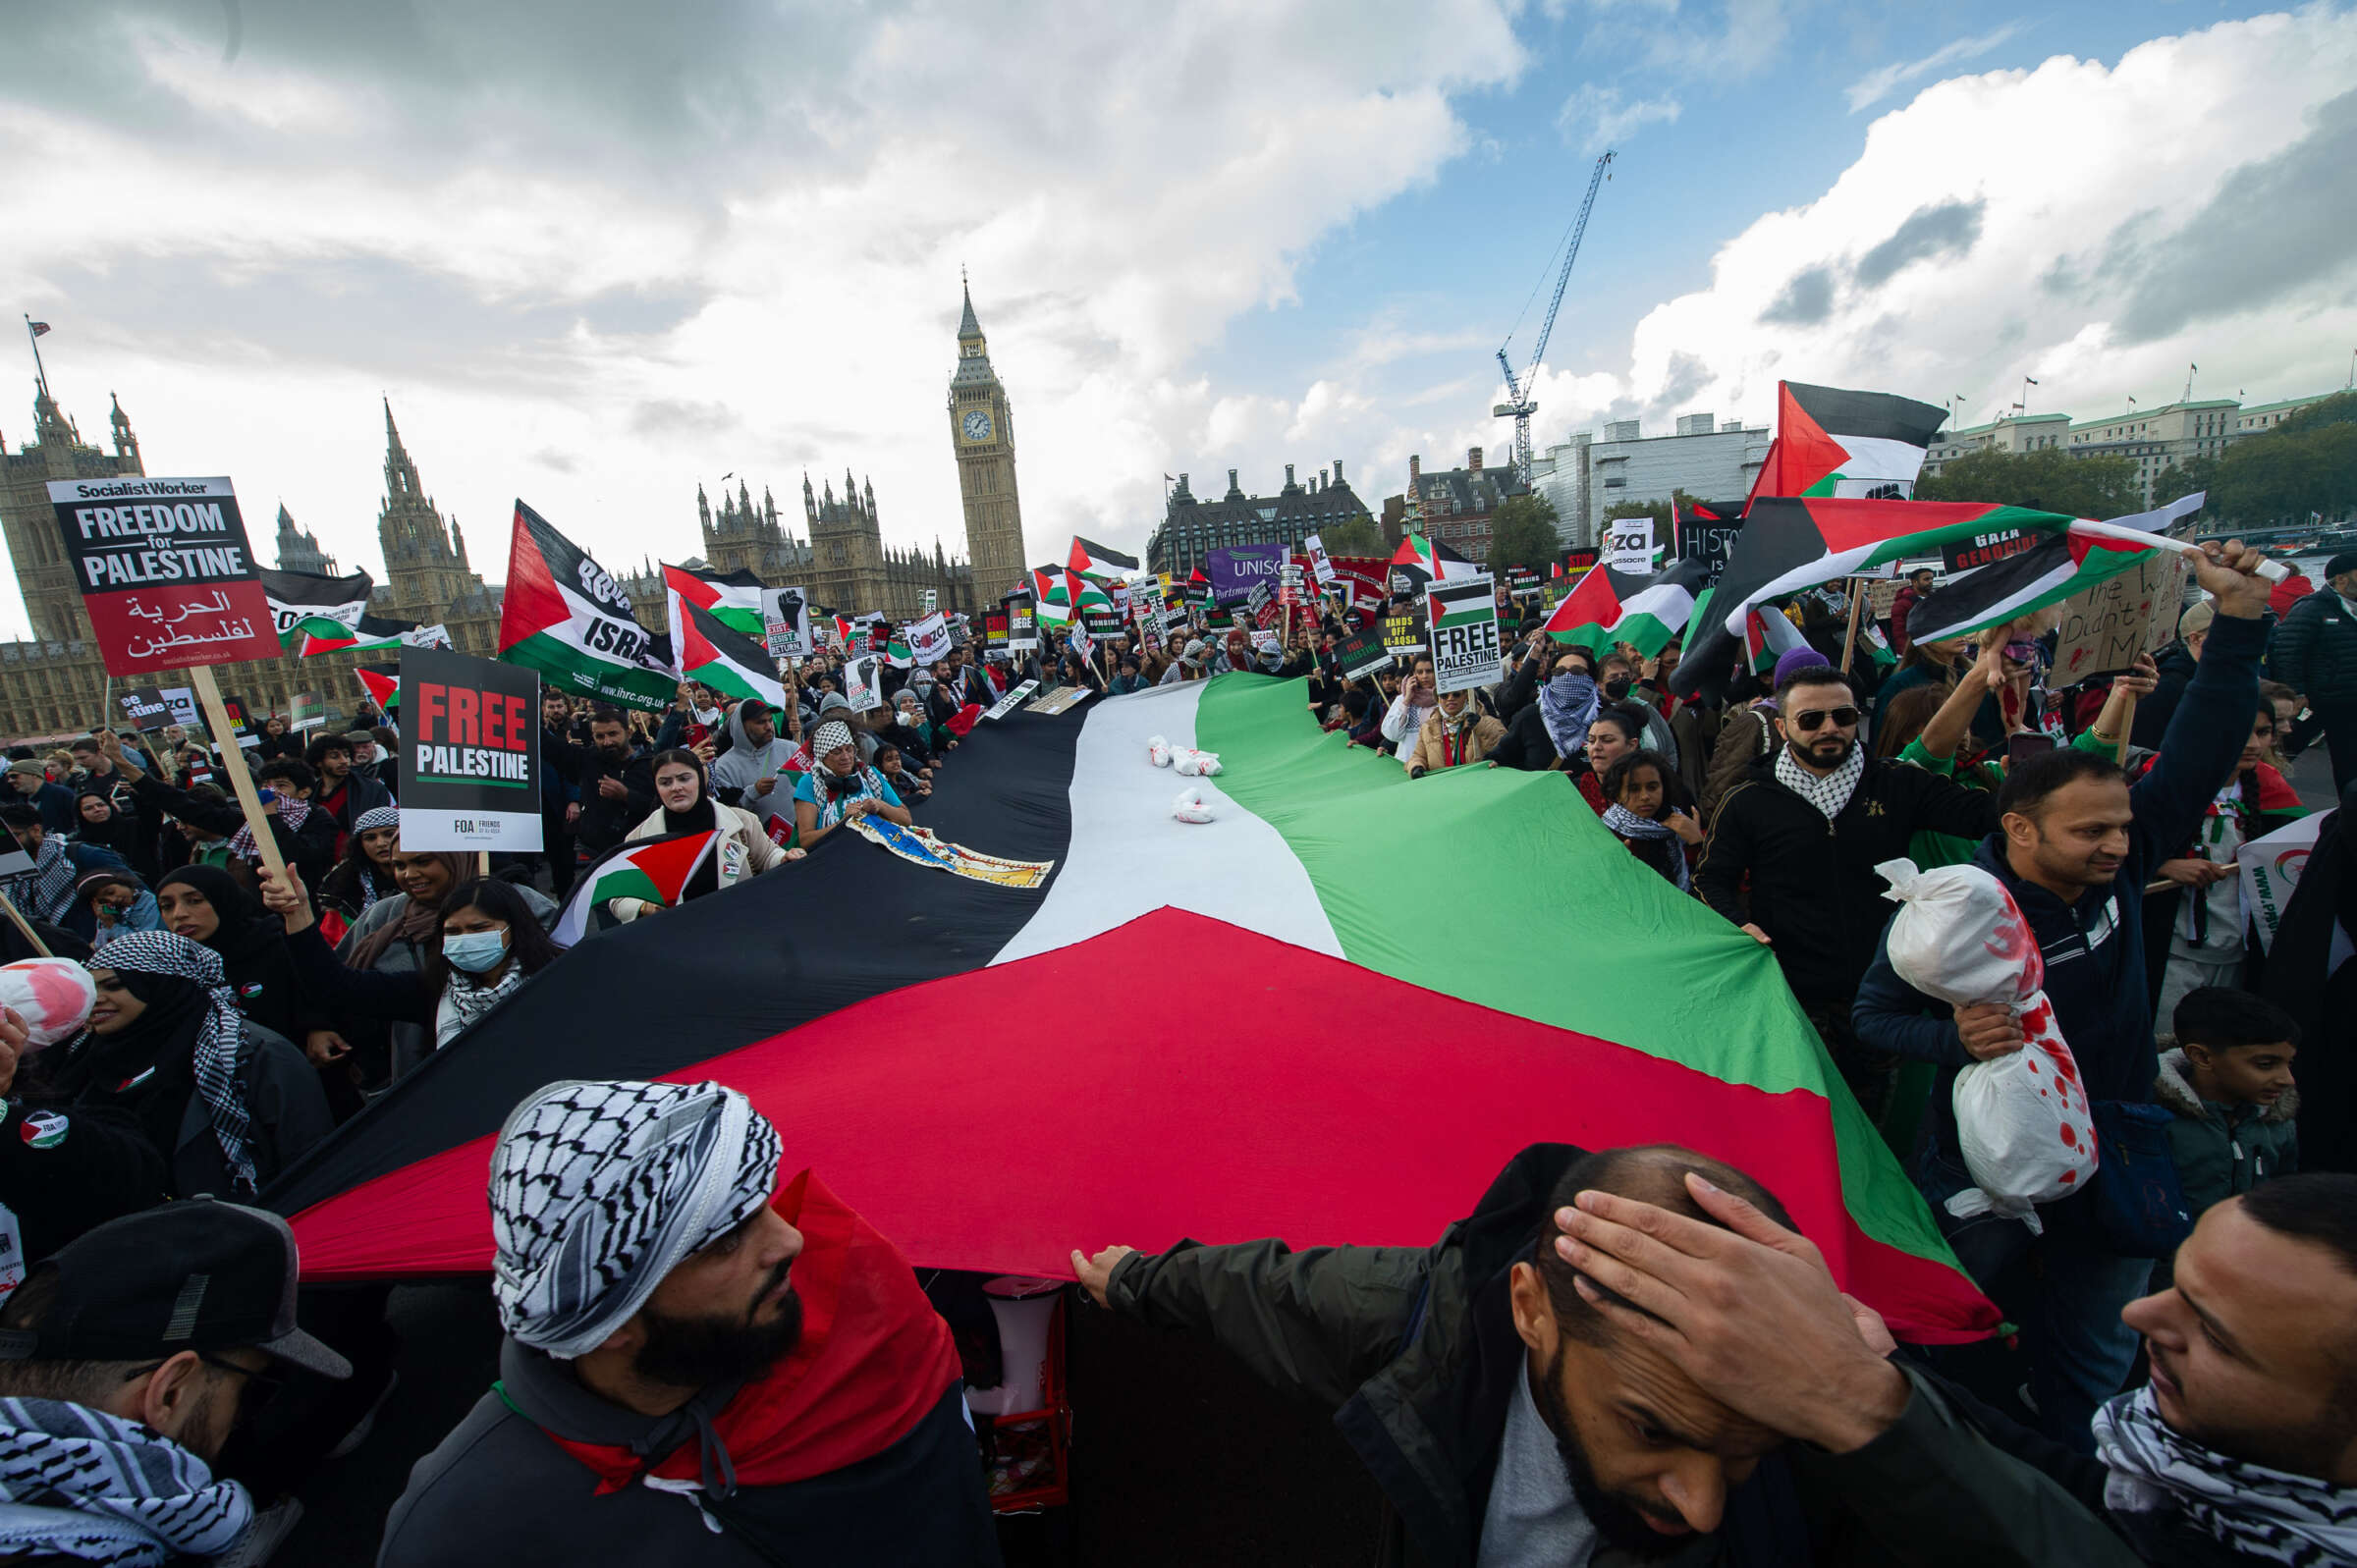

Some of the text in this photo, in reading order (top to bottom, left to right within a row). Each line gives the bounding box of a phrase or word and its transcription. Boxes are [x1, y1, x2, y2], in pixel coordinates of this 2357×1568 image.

[75, 503, 227, 539] FREEDOM
[1974, 528, 2020, 548] GAZA
[147, 534, 172, 549] for
[1955, 534, 2038, 568] GENOCIDE
[82, 547, 248, 586] PALESTINE
[126, 590, 232, 624] الحرية
[1386, 617, 1413, 627] HANDS
[127, 618, 256, 658] لفلسطين
[1383, 635, 1417, 646] AL-AQSA
[1392, 627, 1406, 636] OFF
[1434, 622, 1498, 658] FREE
[1436, 648, 1499, 671] PALESTINE
[418, 682, 527, 751] FREE
[416, 744, 528, 781] PALESTINE
[454, 820, 474, 834] FOA
